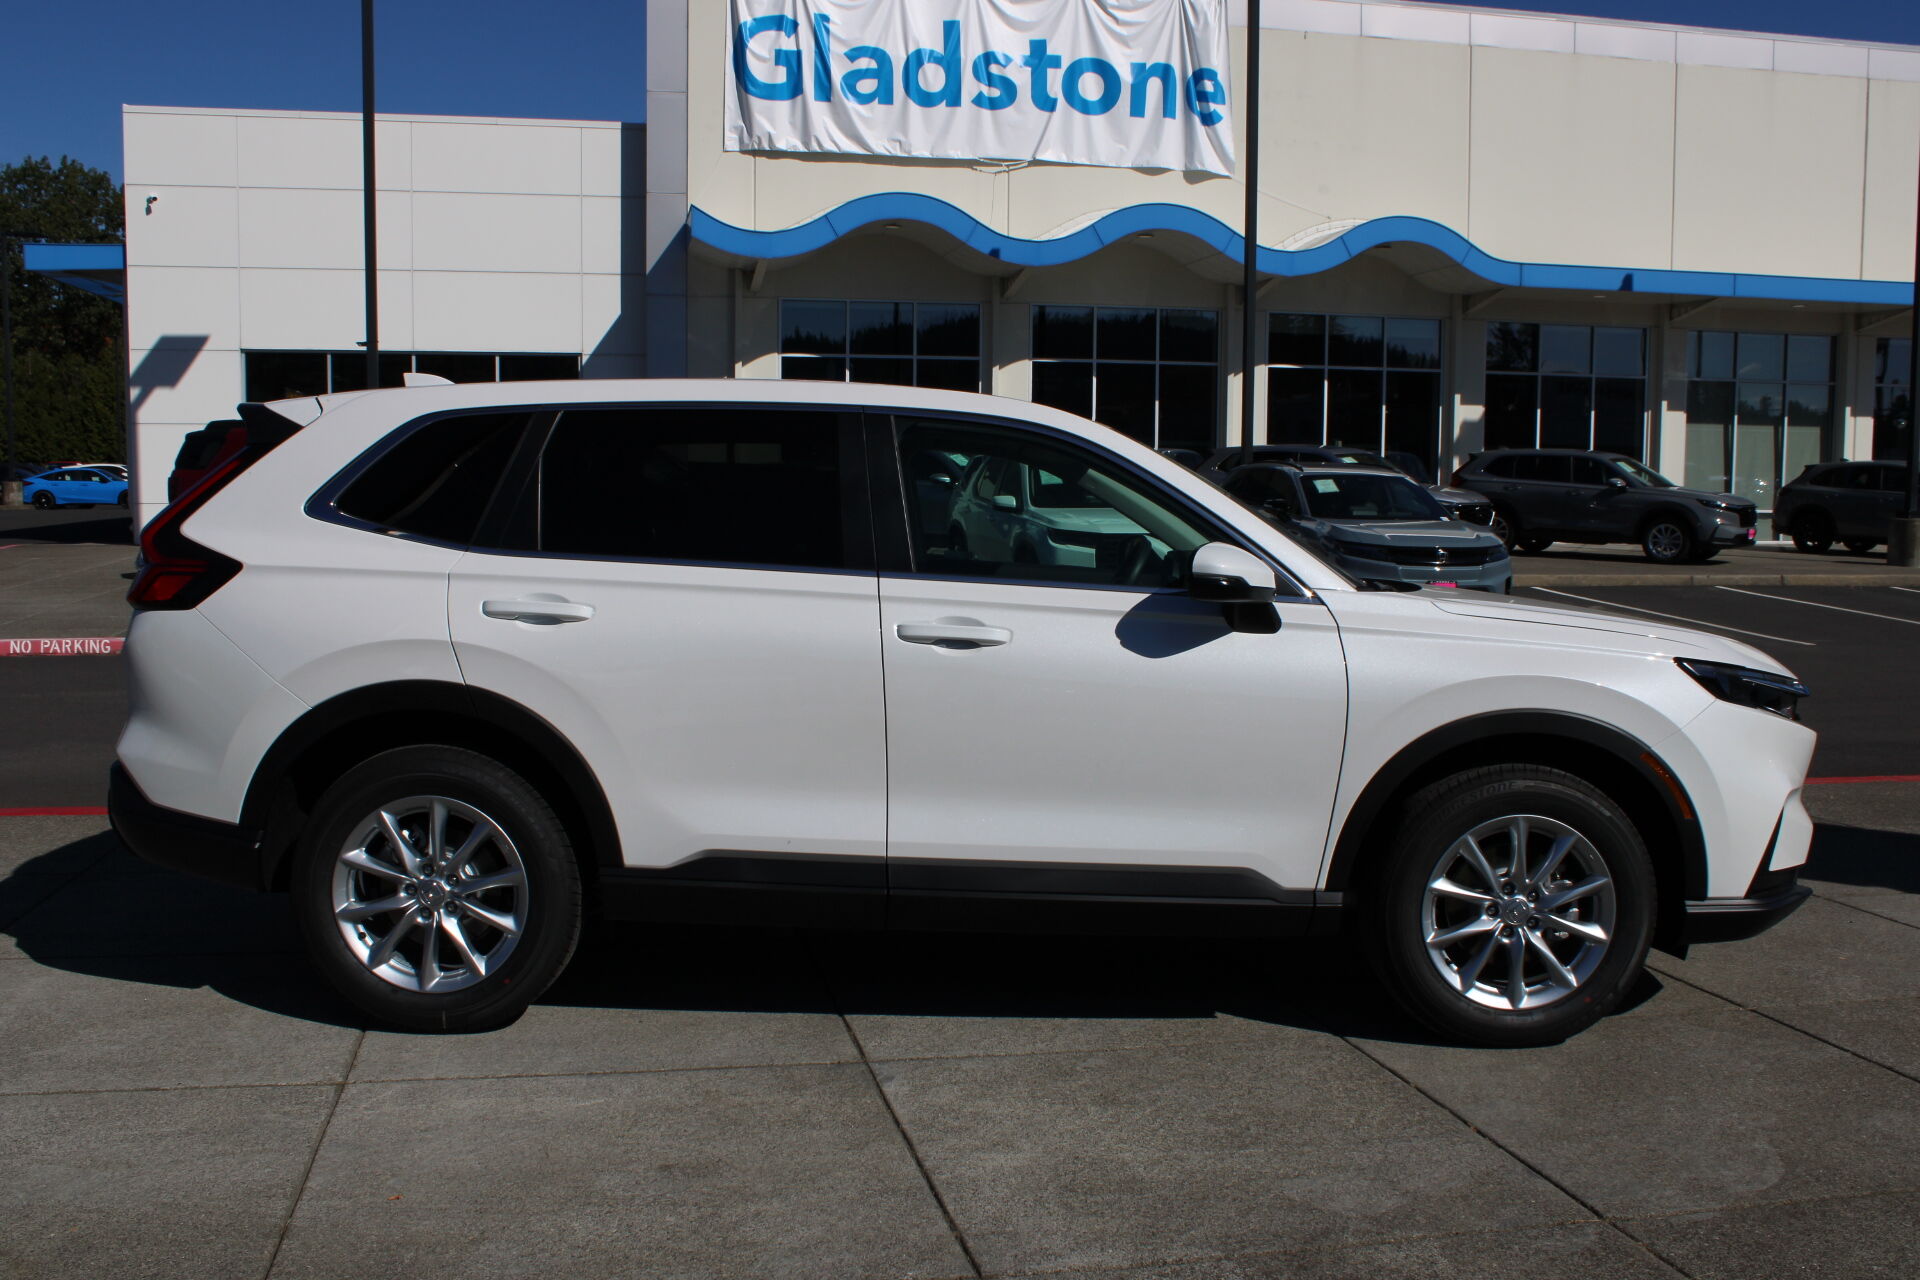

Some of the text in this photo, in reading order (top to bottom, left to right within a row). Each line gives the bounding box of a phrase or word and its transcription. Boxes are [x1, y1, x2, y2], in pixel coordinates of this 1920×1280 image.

[732, 13, 1226, 127] Gladstone
[9, 639, 111, 654] NO PARKING
